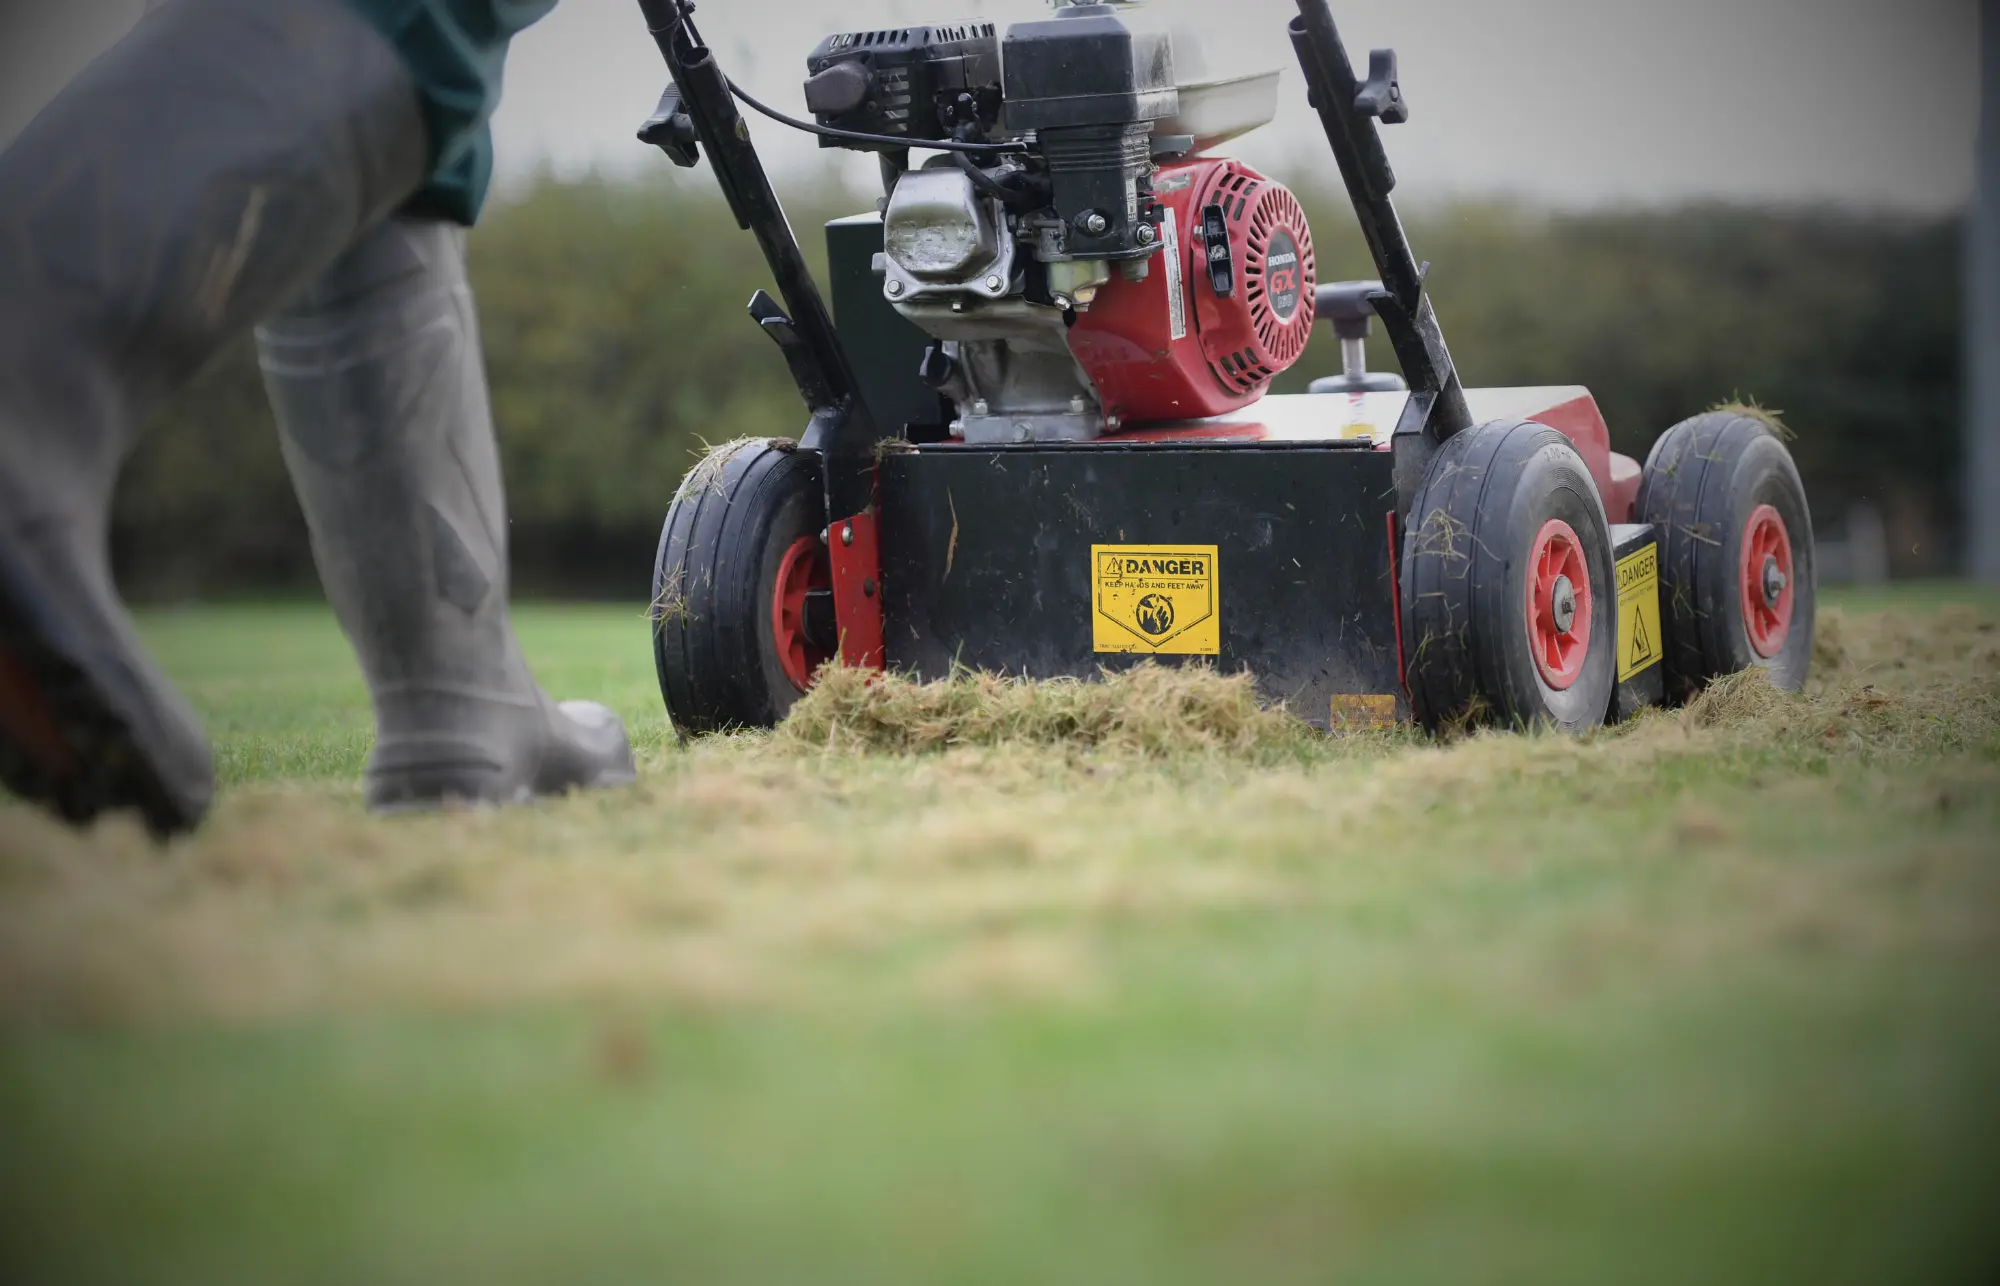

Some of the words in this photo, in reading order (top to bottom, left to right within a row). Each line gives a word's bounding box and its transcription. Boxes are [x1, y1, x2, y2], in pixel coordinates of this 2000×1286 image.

[1268, 252, 1297, 267] HONDA
[1270, 268, 1296, 293] GX
[1126, 559, 1204, 575] DANGER
[1622, 555, 1656, 586] DANGER
[1167, 582, 1185, 590] FEET
